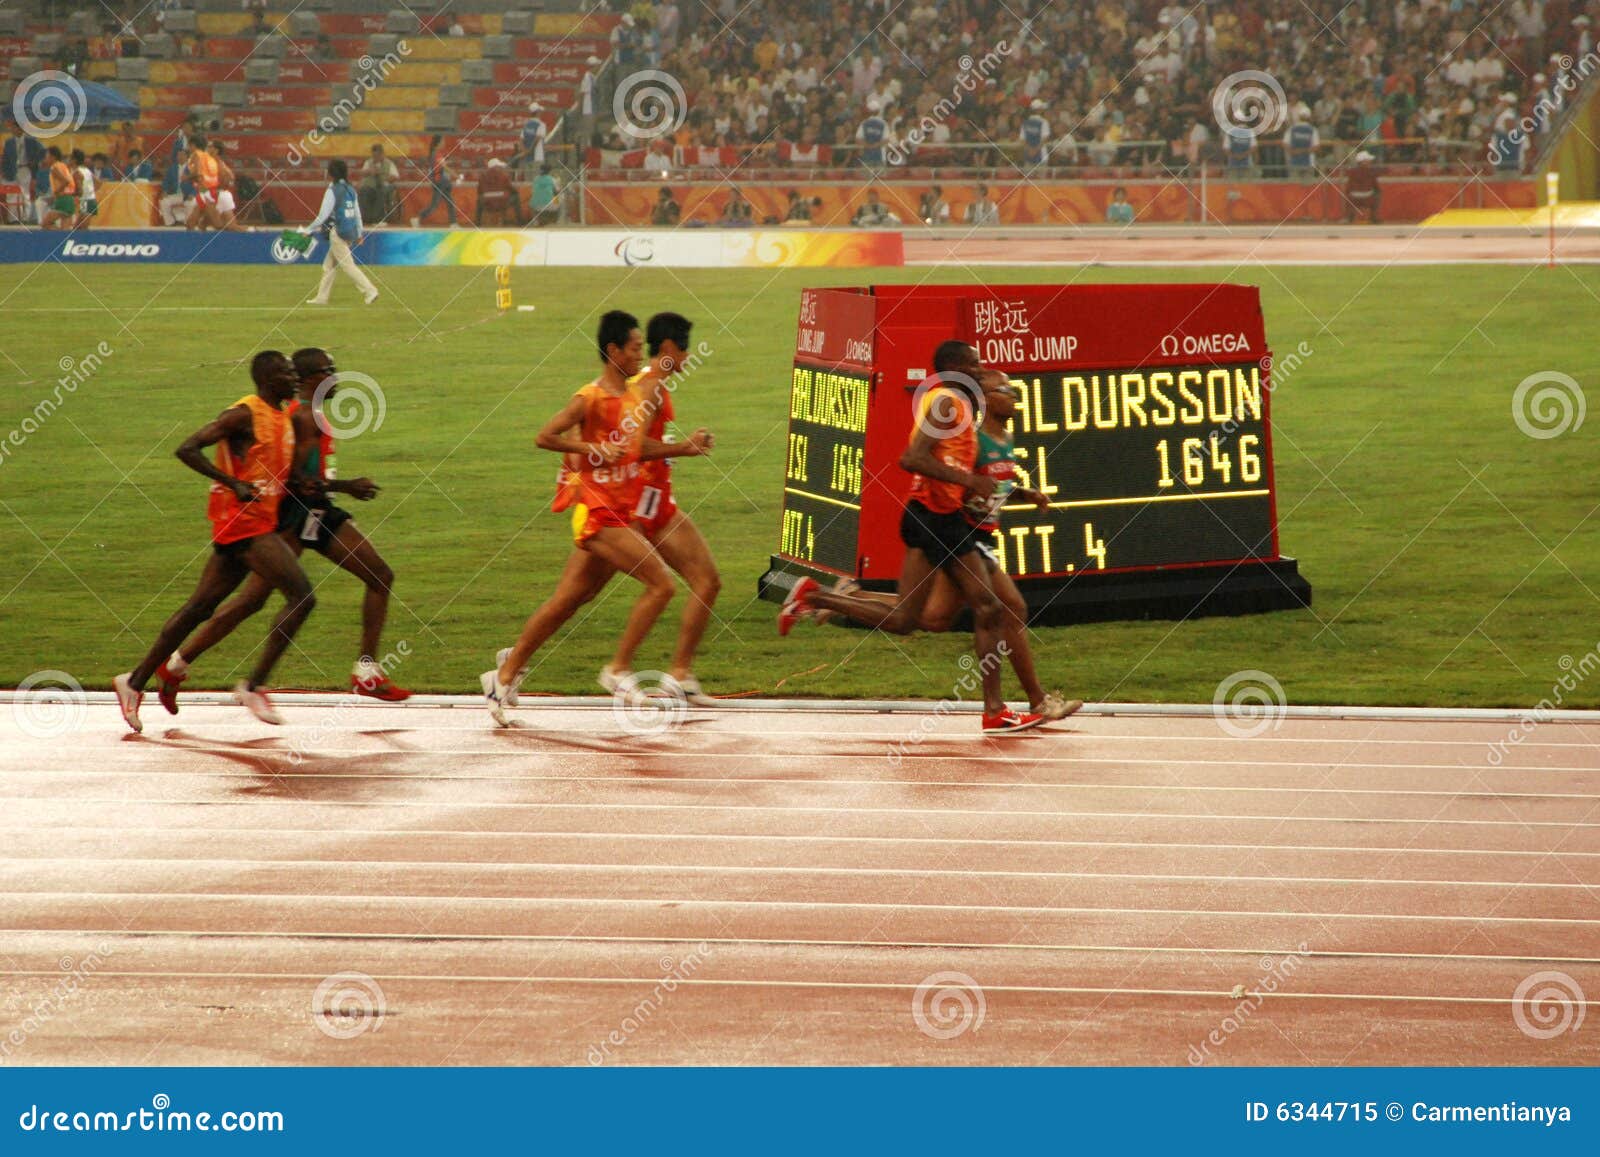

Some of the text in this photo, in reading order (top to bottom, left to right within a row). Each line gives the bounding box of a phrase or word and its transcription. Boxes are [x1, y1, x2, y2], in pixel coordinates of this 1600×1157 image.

[62, 240, 160, 257] lenovo
[974, 300, 1030, 336] 跳远
[976, 336, 1077, 364] LONG JUMP
[1183, 332, 1250, 355] OMEGA
[791, 368, 869, 433] BALDURSSON
[977, 367, 1261, 433] ALDURSSON
[787, 433, 863, 495] ISL 1646
[1155, 434, 1261, 487] 1646
